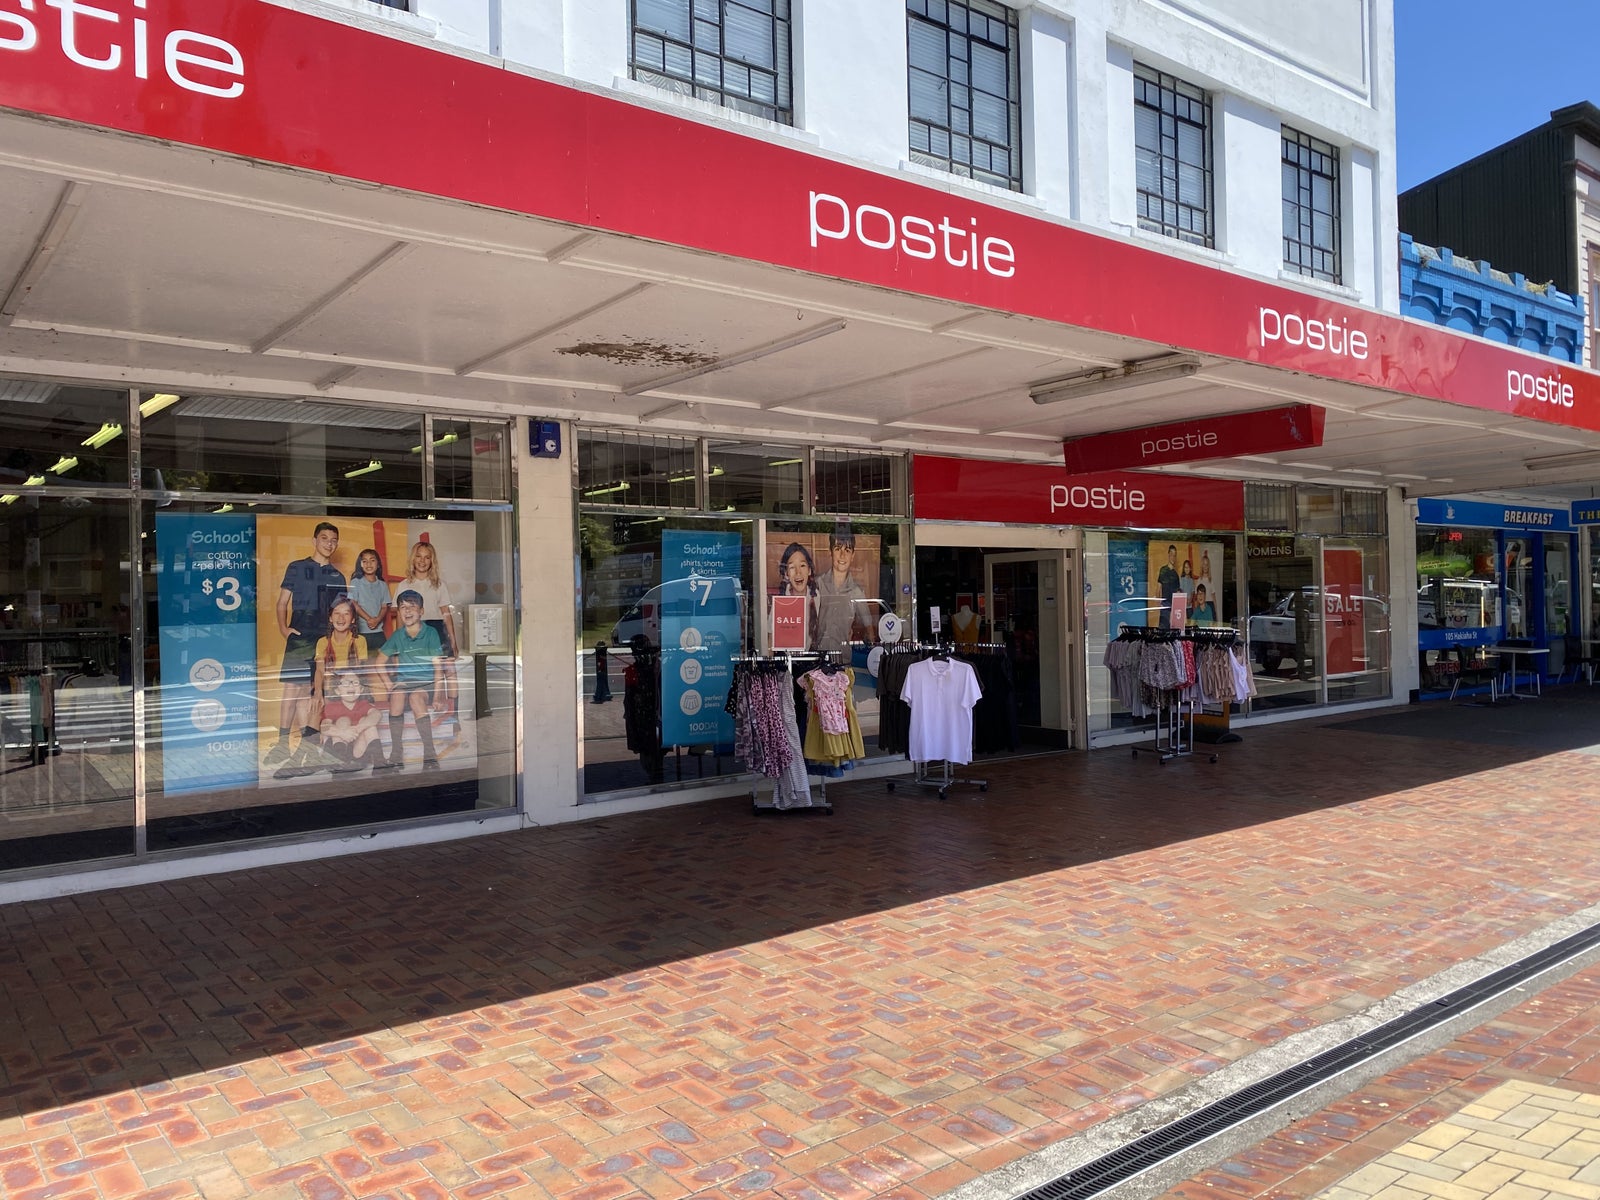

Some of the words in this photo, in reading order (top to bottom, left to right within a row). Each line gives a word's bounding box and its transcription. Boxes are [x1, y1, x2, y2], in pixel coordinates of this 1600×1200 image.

[809, 190, 1016, 278] postie
[1259, 306, 1369, 360] postie
[1507, 368, 1575, 408] postie
[1141, 429, 1218, 458] postie
[1050, 481, 1146, 513] postie
[1503, 510, 1554, 526] BREAKFAST
[207, 551, 243, 560] cotton
[227, 561, 251, 570] shirt
[697, 568, 717, 576] skorts
[201, 576, 242, 611] $3
[1327, 596, 1361, 614] SALE
[776, 616, 802, 624] SALE
[1445, 632, 1454, 641] 105
[1434, 660, 1461, 674] OPEN
